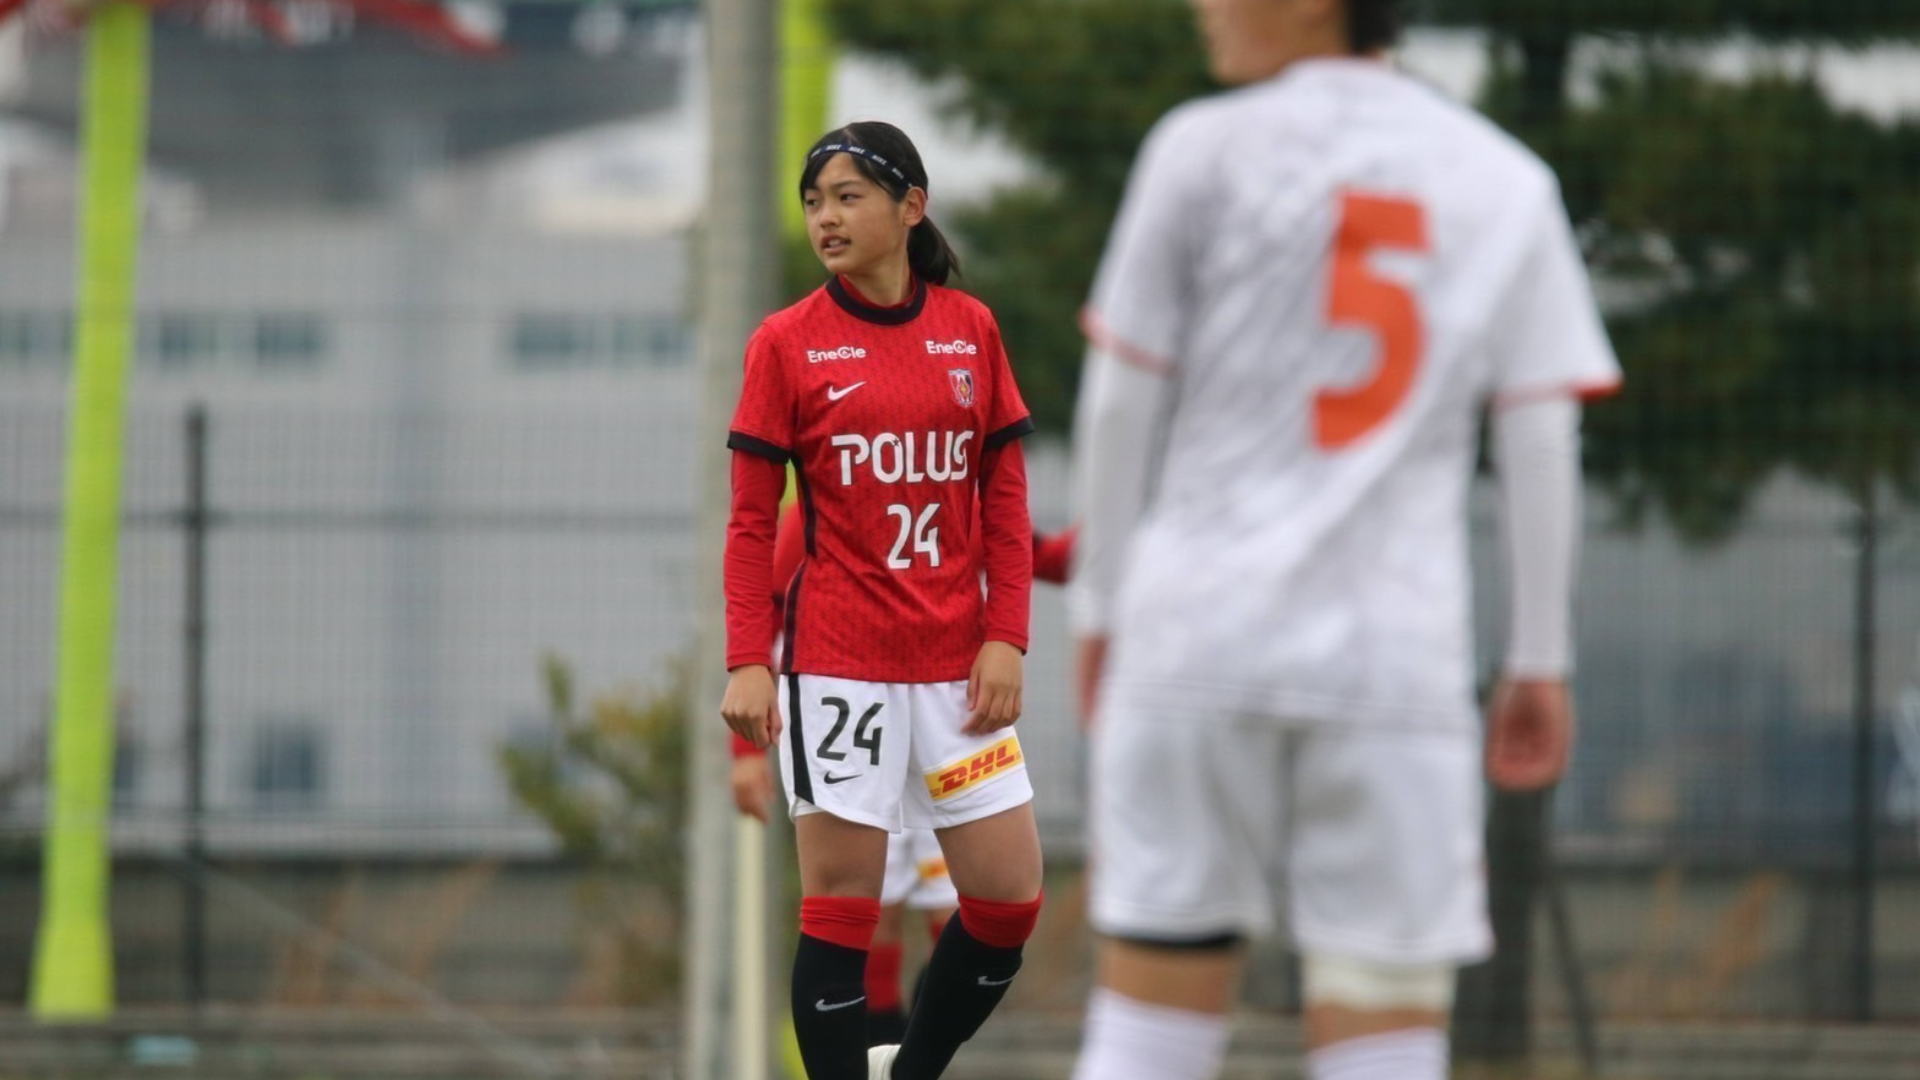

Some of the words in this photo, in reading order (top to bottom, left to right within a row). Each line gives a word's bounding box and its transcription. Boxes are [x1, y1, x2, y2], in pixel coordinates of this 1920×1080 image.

[1312, 191, 1429, 451] 5
[807, 346, 867, 364] EneCle
[831, 430, 975, 486] POLUS
[886, 503, 941, 570] 24
[816, 696, 885, 766] 24
[938, 745, 1015, 793] DHL
